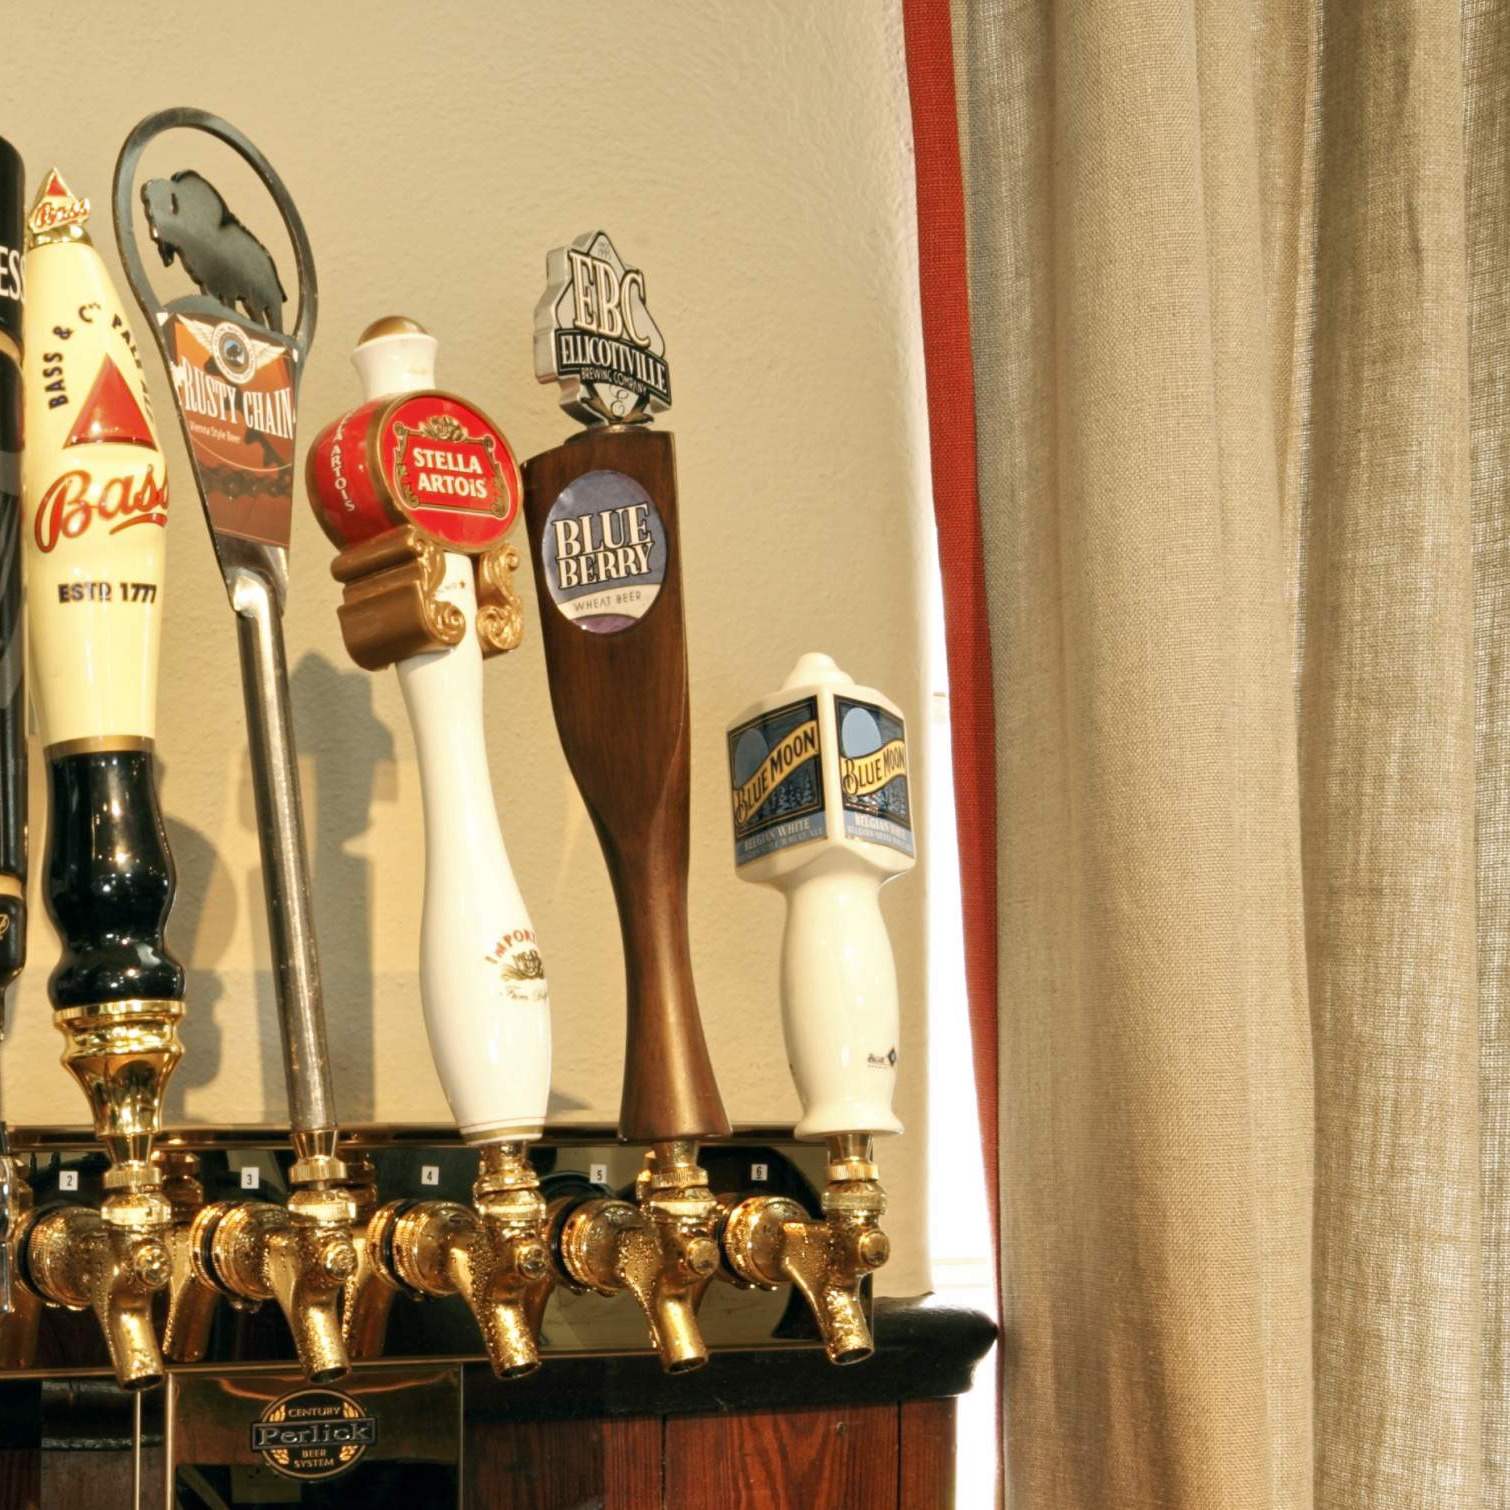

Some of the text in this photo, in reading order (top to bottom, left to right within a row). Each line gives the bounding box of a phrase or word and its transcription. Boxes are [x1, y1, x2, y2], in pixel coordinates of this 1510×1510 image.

[567, 250, 652, 348] EBC
[52, 326, 74, 341] &
[42, 352, 70, 411] BASS
[559, 334, 668, 395] ELLICOTTVILLE
[180, 355, 238, 425] RUSTY
[242, 387, 294, 441] CHAIN
[412, 446, 484, 475] STELLA
[330, 444, 356, 513] ARTOIS
[552, 501, 653, 560] BLUE
[556, 540, 654, 591] BERRY
[120, 582, 158, 604] 1777
[572, 590, 642, 613] WHEAT BEER
[770, 725, 817, 783] MOON
[843, 758, 882, 797] BLUE
[777, 816, 811, 838] WHITE
[288, 1406, 341, 1418] CENTURY
[257, 1423, 371, 1446] Perlick
[293, 1458, 335, 1469] SYSTEM
[301, 1448, 327, 1458] BEER
